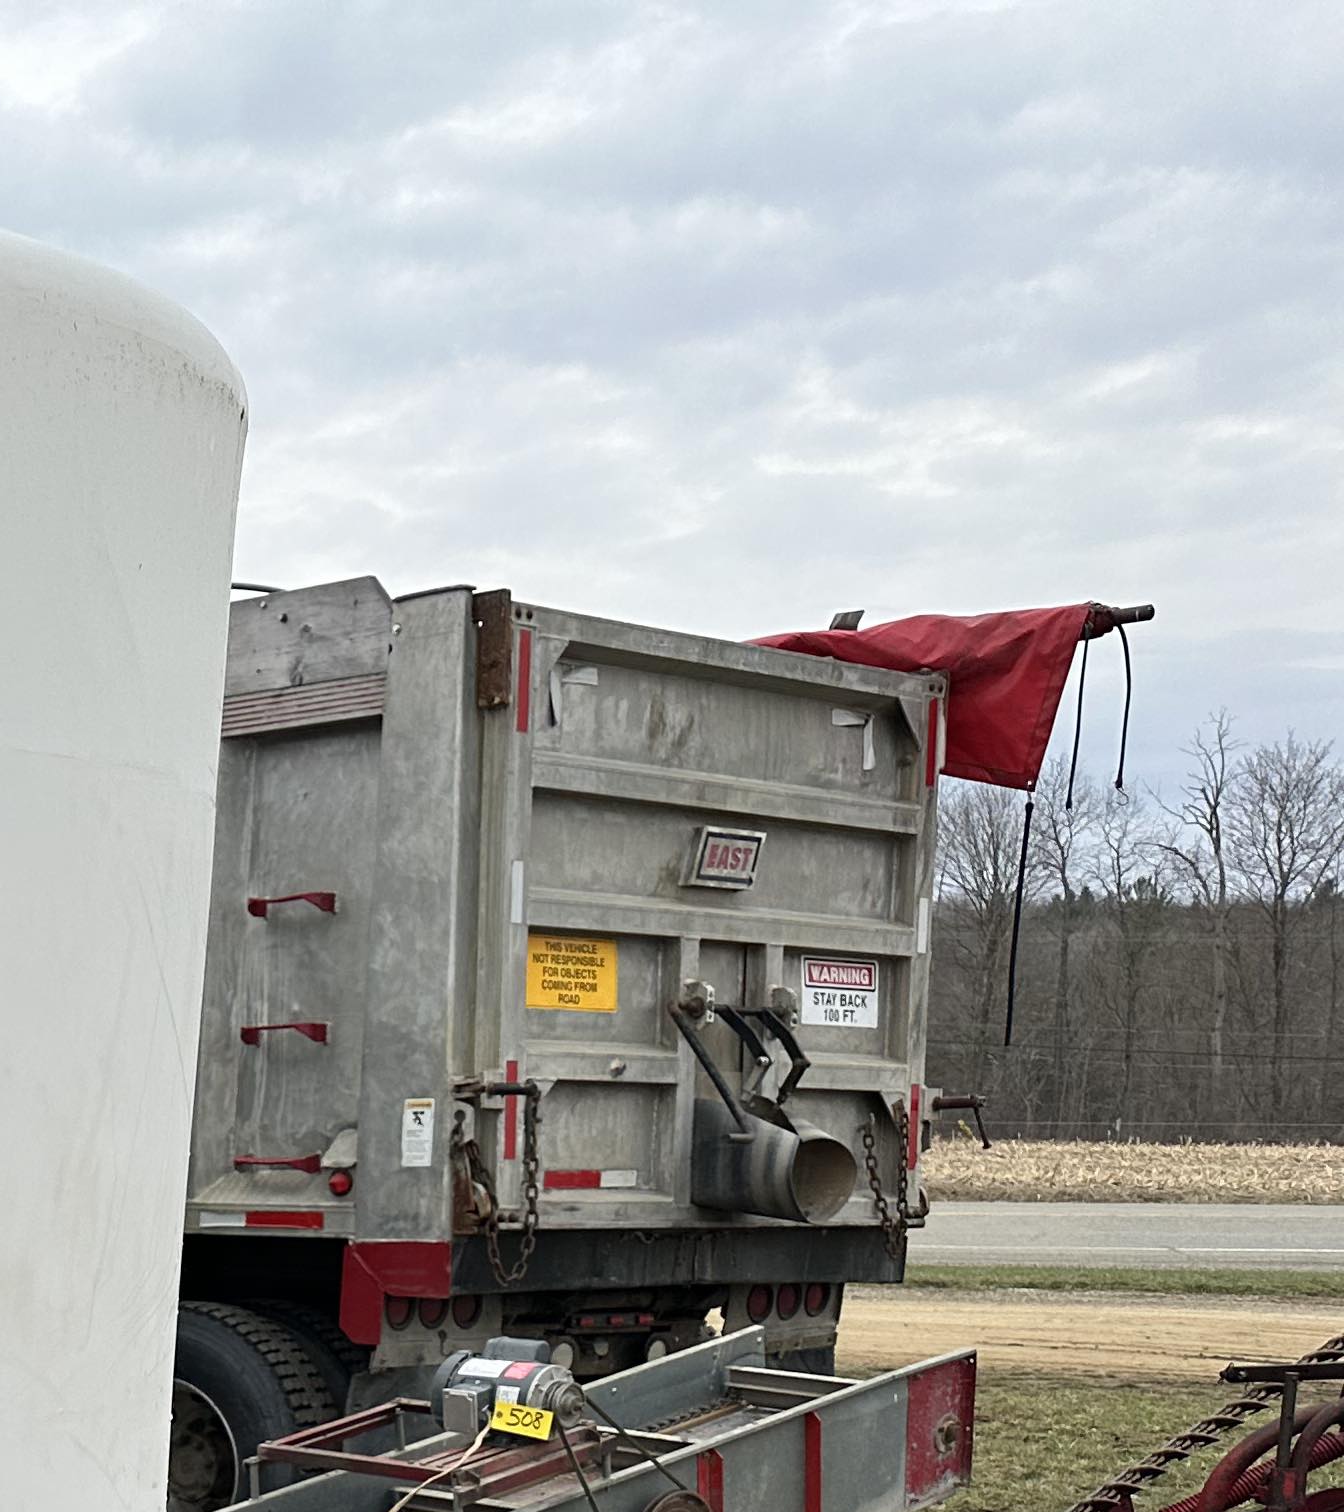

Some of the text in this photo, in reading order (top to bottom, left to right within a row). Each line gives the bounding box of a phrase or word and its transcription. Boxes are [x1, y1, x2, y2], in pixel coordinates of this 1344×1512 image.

[706, 844, 754, 872] EAST
[544, 941, 598, 954] THIS VEHICLE
[532, 952, 605, 968] NOT RESPONSIBLE
[542, 966, 597, 980] FOR OBJECTS
[810, 964, 870, 985] WARNING
[542, 979, 598, 992] COMING FROM
[558, 993, 580, 1005] ROAD
[813, 992, 868, 1008] STAY BACK
[824, 1008, 858, 1024] 100 FT.
[506, 1408, 544, 1430] 508
